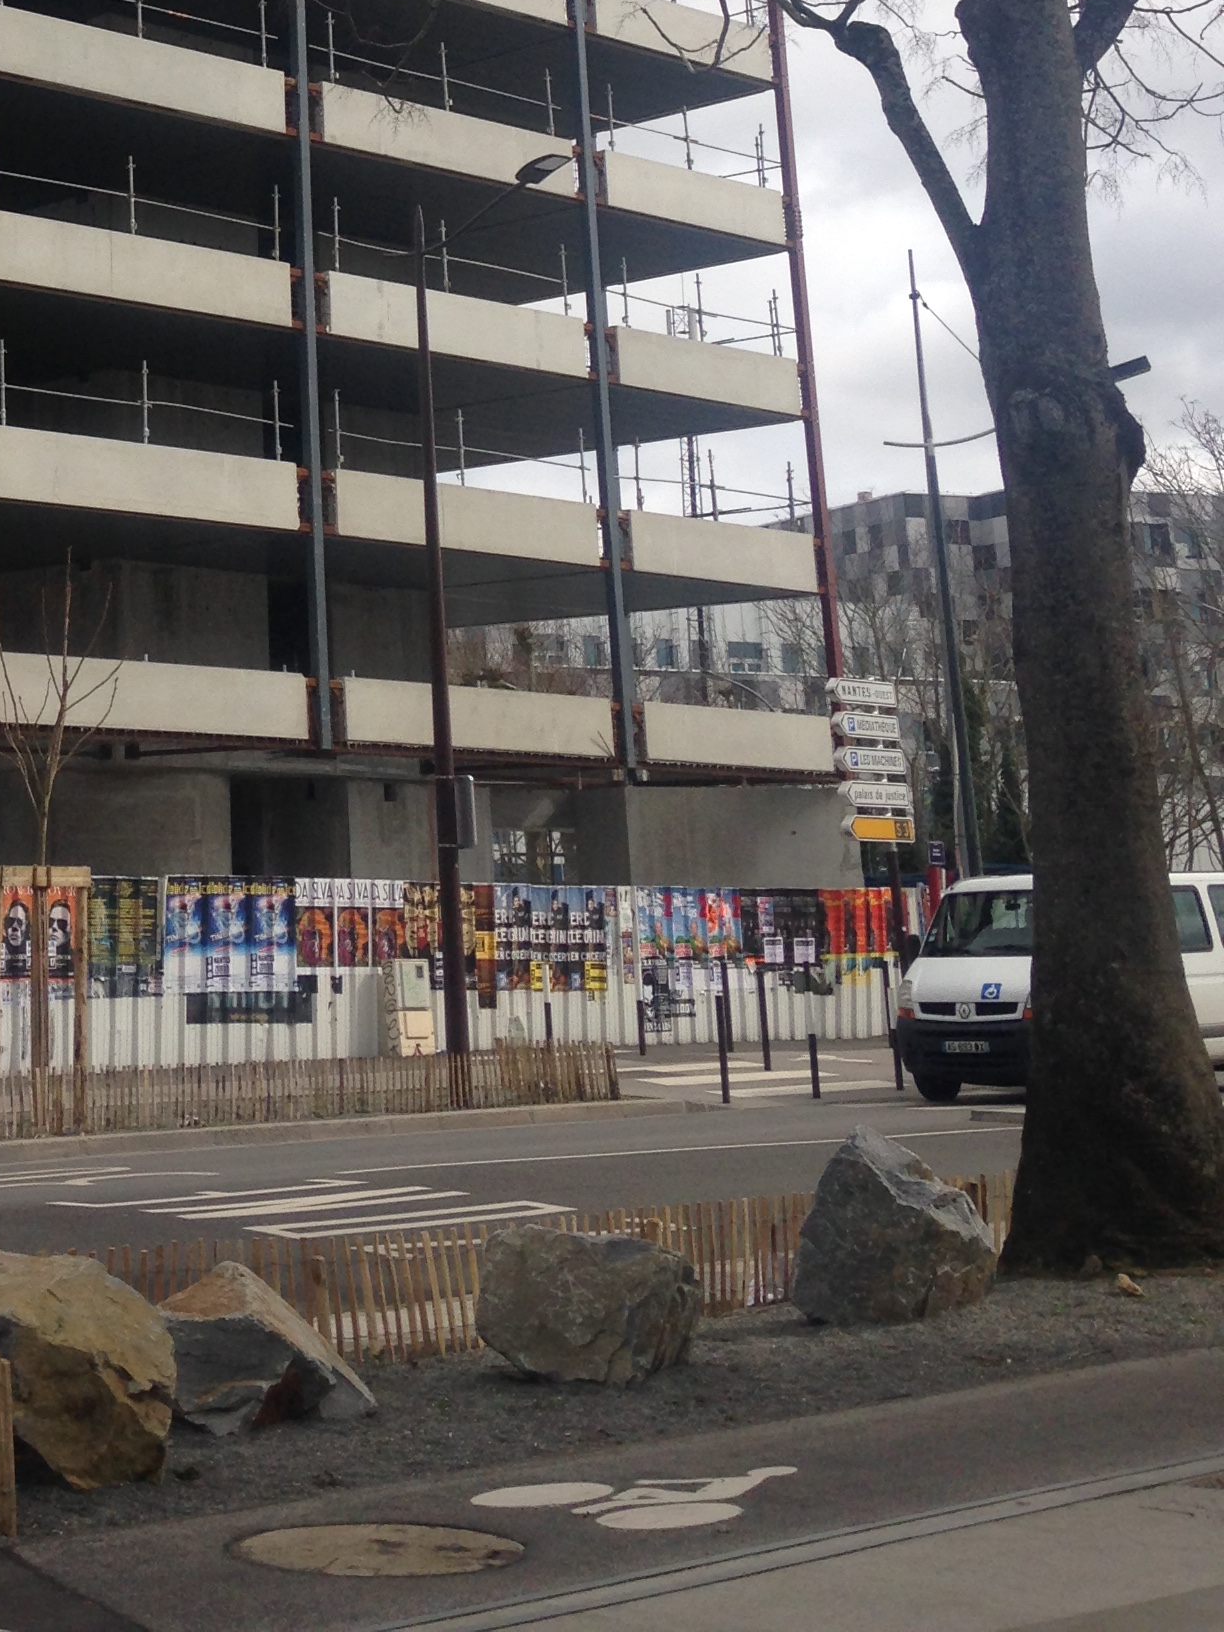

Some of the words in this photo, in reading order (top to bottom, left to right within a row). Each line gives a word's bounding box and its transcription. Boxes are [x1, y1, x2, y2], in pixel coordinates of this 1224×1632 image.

[841, 684, 871, 698] NANTES
[854, 789, 873, 801] palais
[875, 790, 883, 800] de
[885, 790, 906, 802] justice
